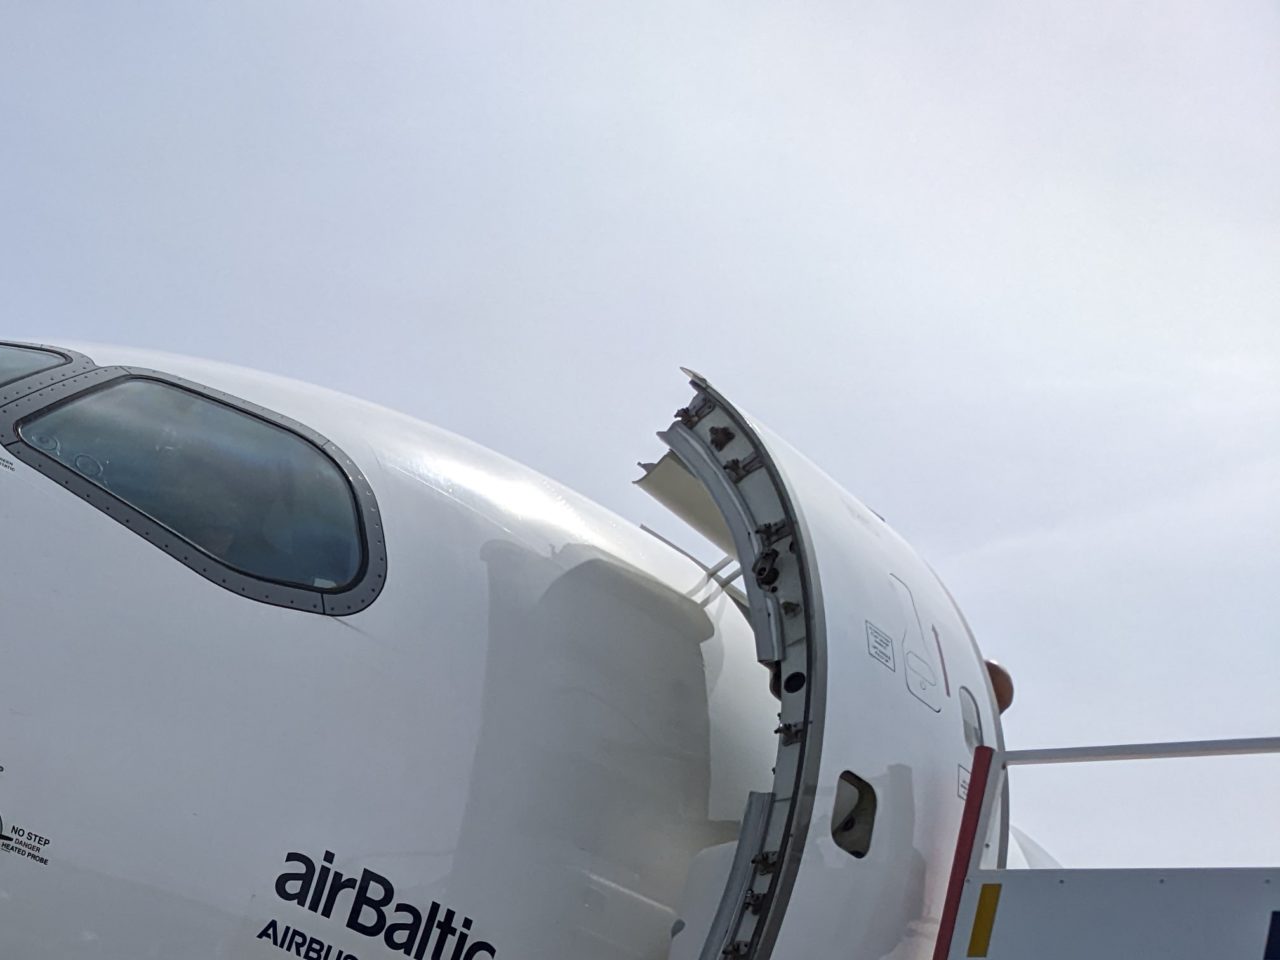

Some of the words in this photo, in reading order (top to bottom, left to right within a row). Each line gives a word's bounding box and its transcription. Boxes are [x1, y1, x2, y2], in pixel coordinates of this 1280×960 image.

[11, 825, 25, 837] NO
[26, 832, 50, 846] STEP
[14, 838, 41, 853] DANGER
[1, 842, 26, 856] HEATED
[27, 852, 49, 865] PROBE
